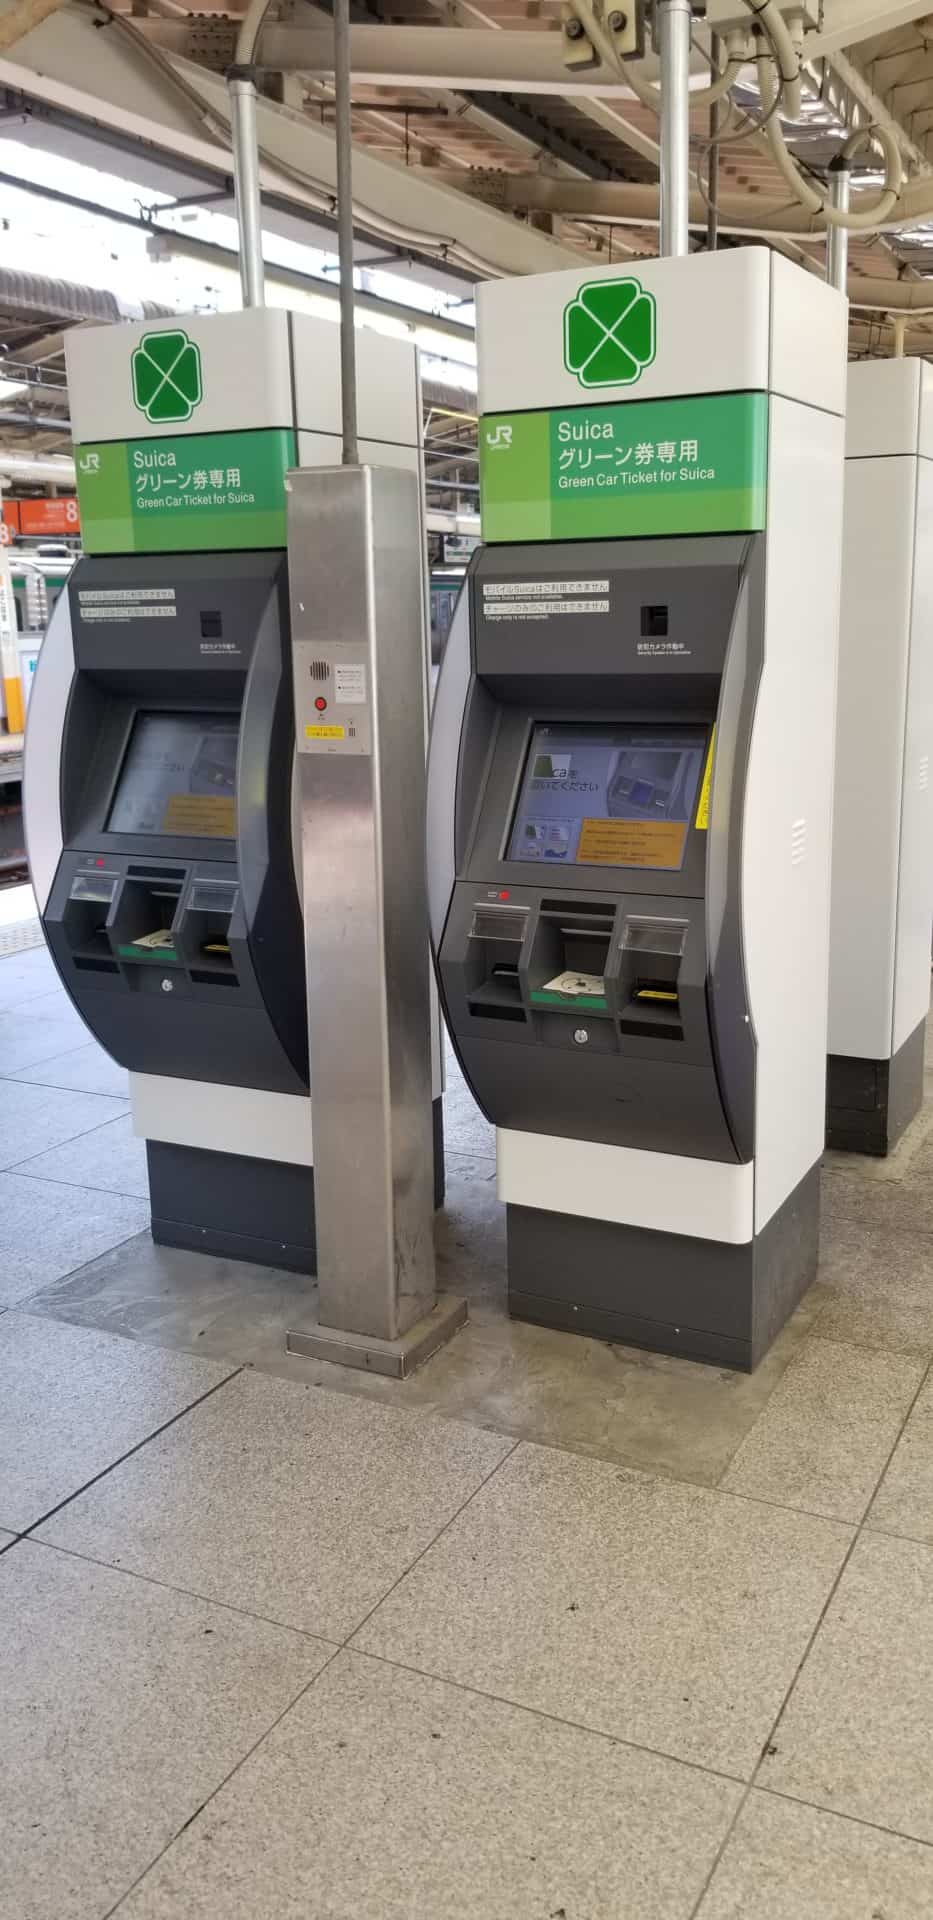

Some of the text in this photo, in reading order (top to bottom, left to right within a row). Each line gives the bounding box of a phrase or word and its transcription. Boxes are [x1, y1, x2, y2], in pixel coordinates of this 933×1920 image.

[487, 425, 513, 445] JR
[557, 420, 614, 442] Suica
[79, 453, 100, 470] JR
[133, 449, 177, 469] Suica
[558, 440, 699, 470] グリーン券専用
[135, 468, 241, 493] グリーン券専用
[558, 467, 715, 489] Green Car Ticket for Suica
[137, 492, 255, 509] Green Car Ticket for Suica
[66, 501, 78, 523] 8
